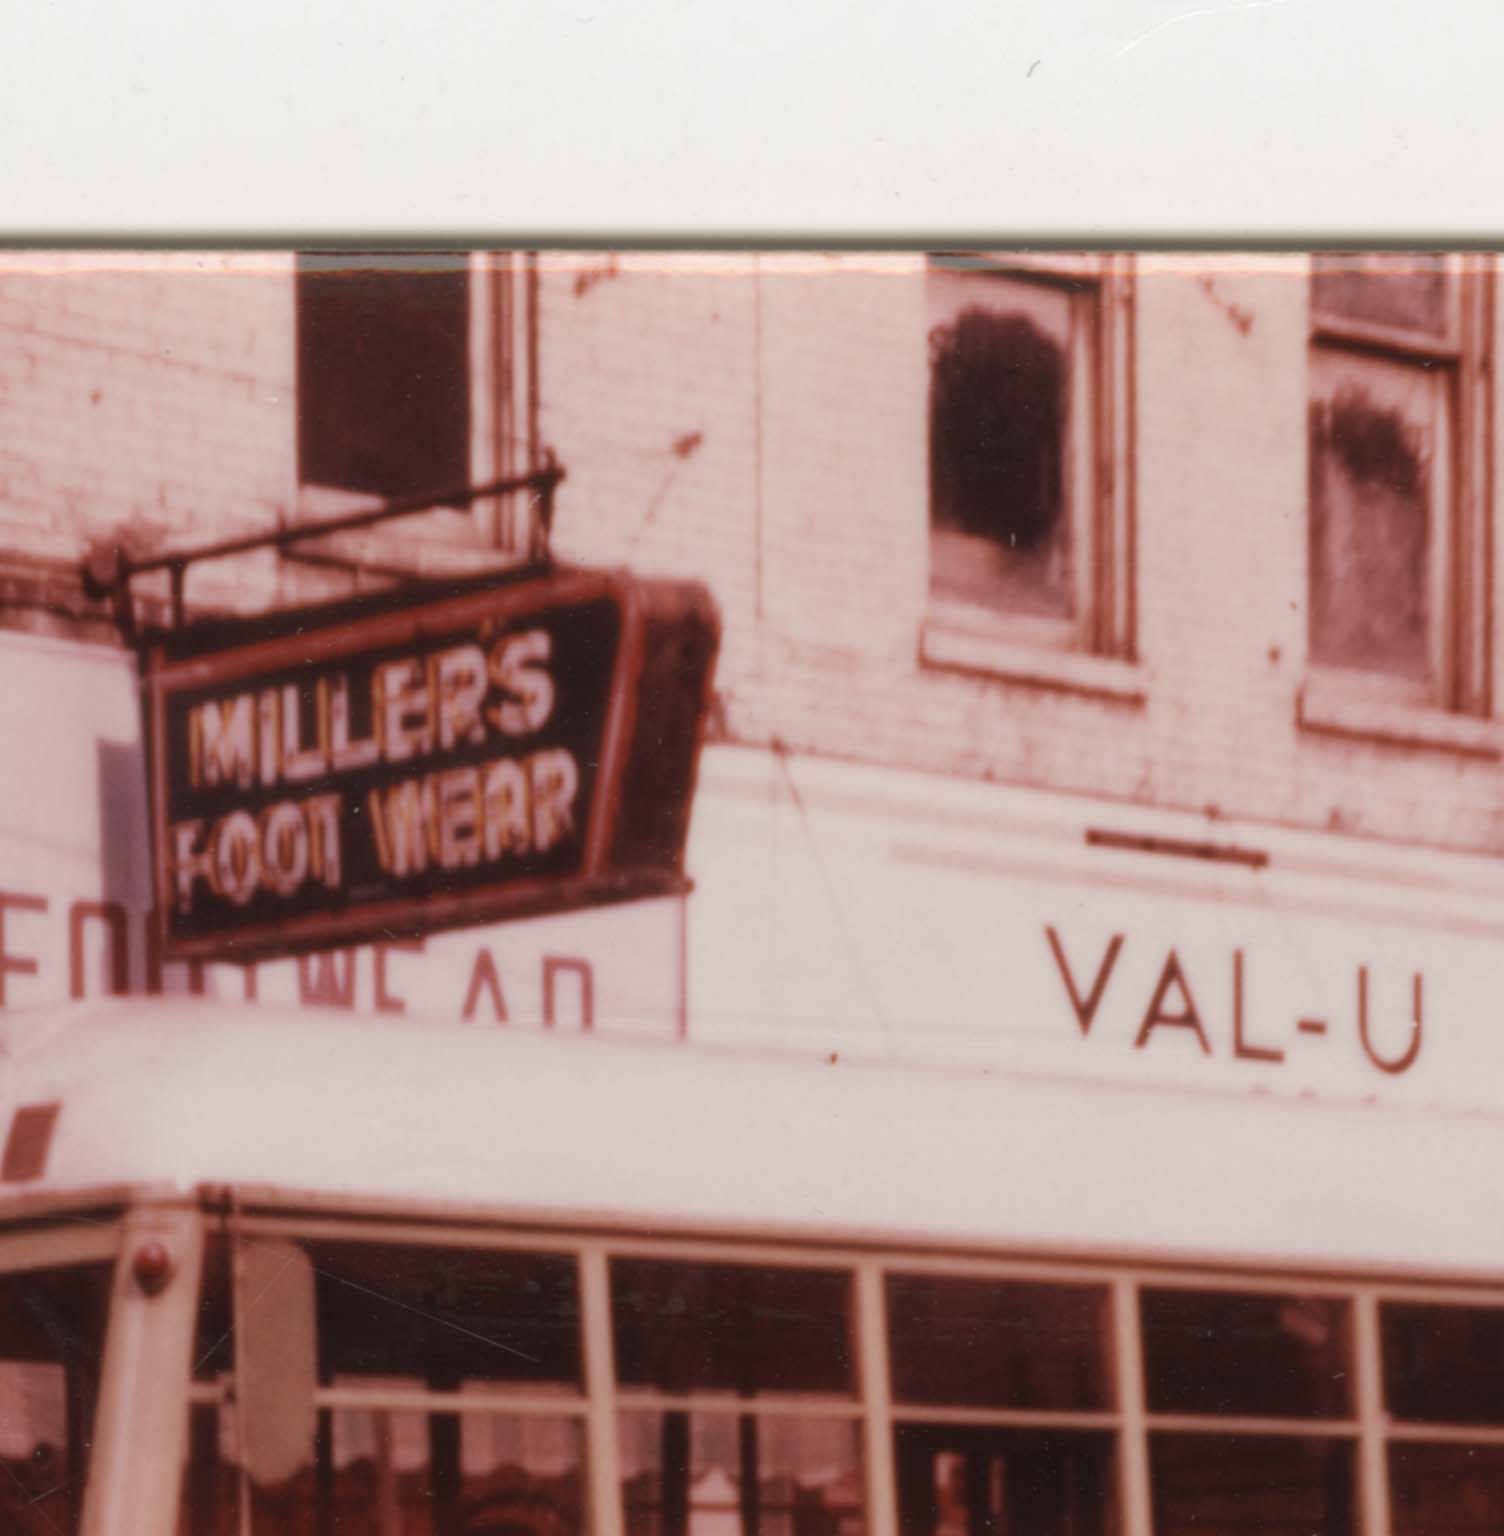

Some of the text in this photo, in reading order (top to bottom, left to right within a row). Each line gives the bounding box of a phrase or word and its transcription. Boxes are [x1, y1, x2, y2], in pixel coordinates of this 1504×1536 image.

[174, 748, 579, 915] FOOT WEAR
[1043, 923, 1423, 1076] VAL-U
